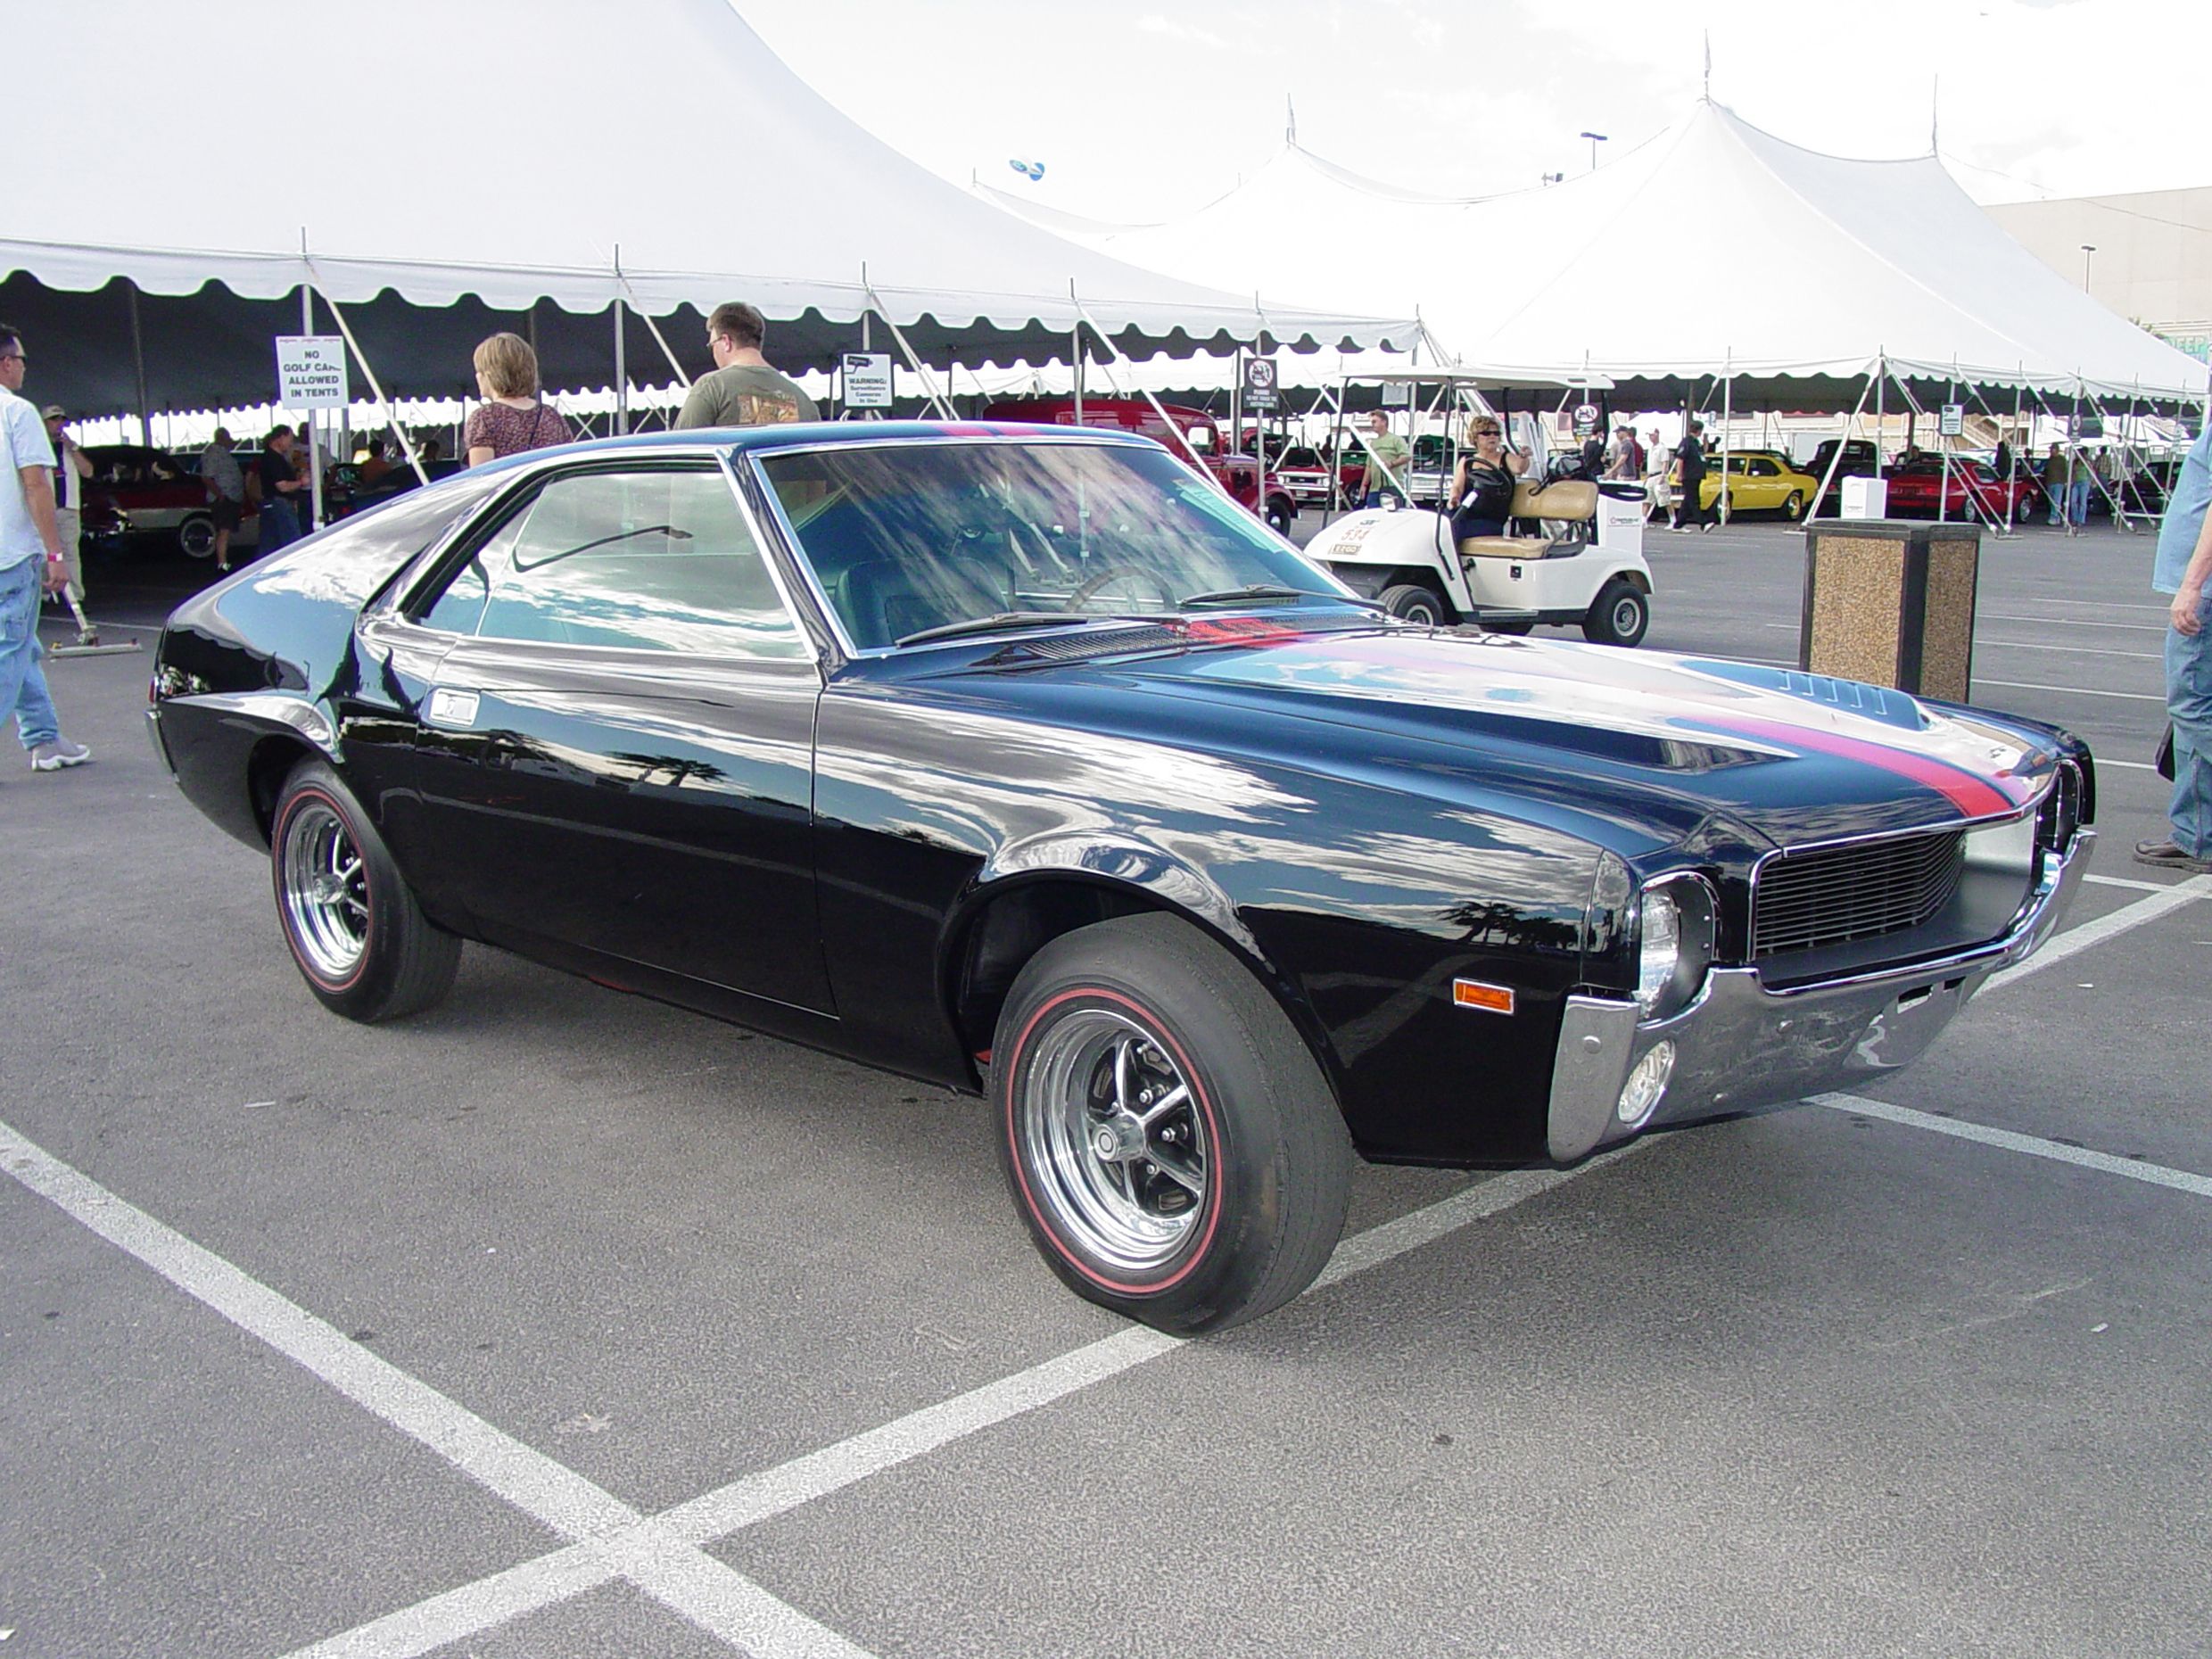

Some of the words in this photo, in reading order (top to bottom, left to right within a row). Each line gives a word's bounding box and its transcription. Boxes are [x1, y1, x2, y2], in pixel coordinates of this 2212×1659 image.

[304, 351, 319, 359] NO
[284, 363, 310, 372] GOLF
[288, 376, 339, 384] ALLOWED
[291, 389, 301, 397] IN
[304, 388, 339, 397] TENTS
